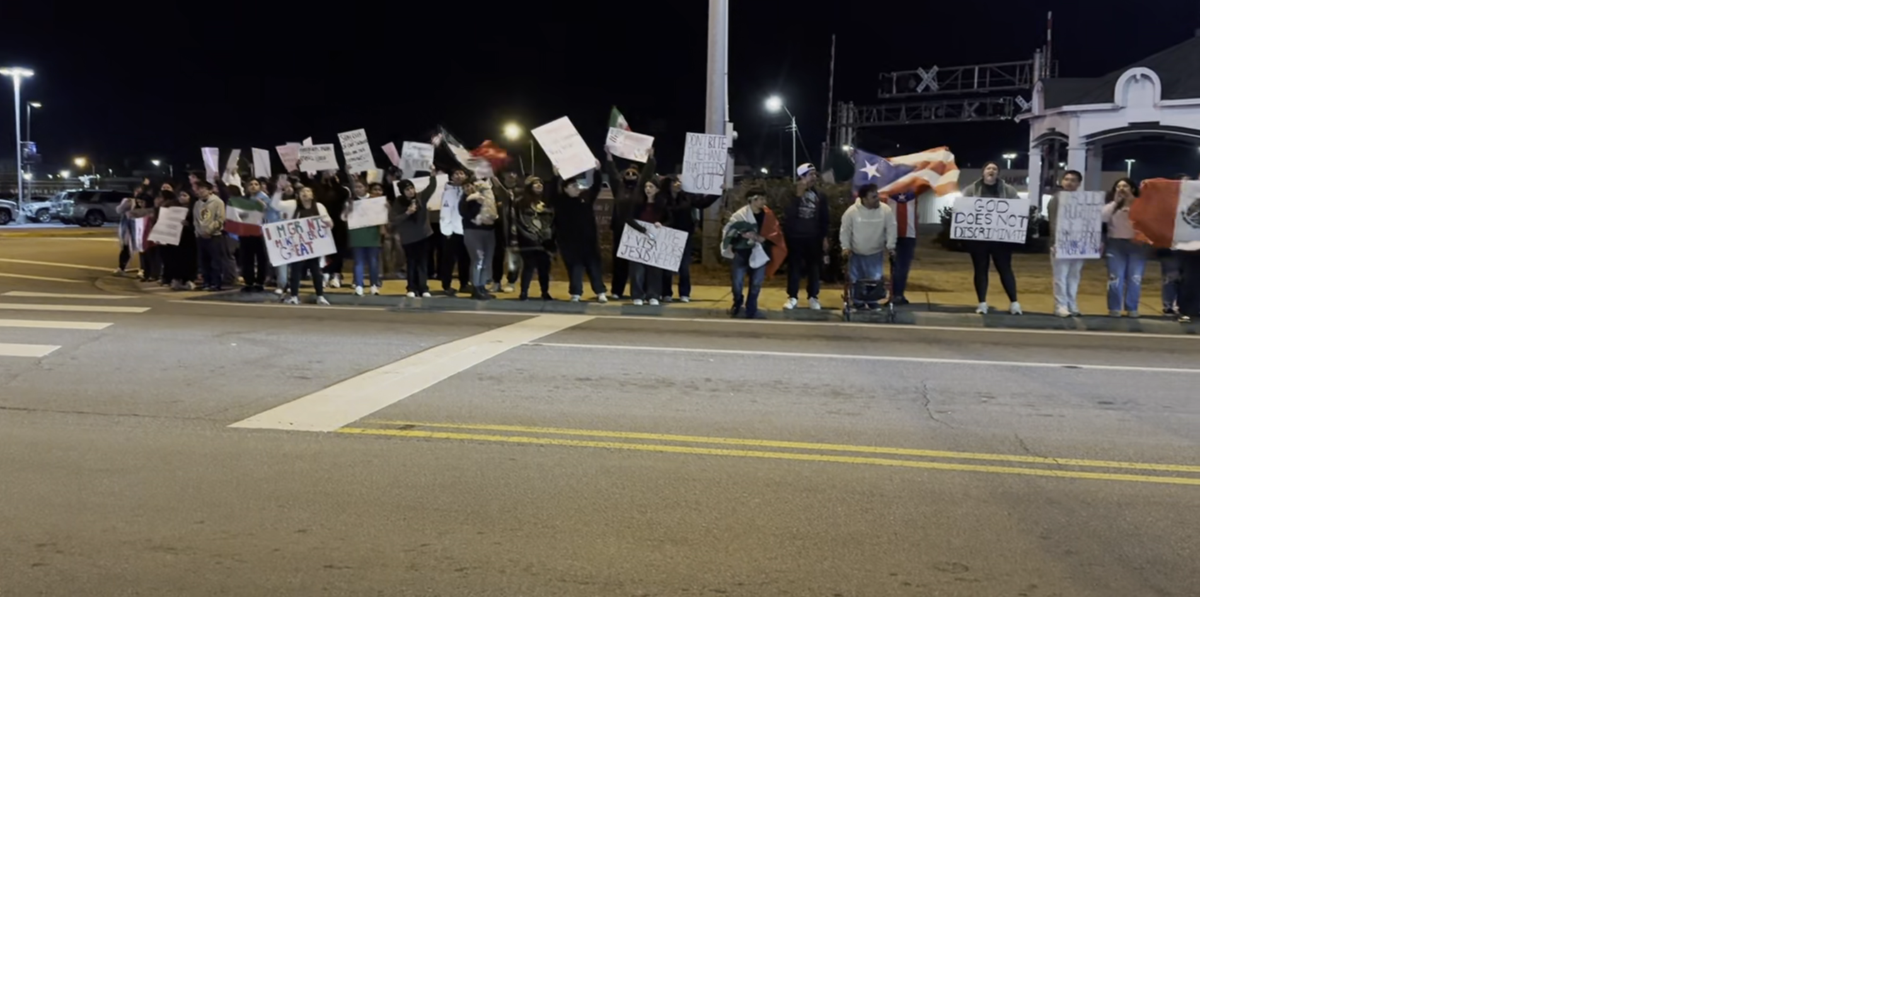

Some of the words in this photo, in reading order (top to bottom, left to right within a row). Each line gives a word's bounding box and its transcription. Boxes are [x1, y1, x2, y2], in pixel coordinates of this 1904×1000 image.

[708, 136, 727, 149] BITE
[974, 199, 1010, 214] GOD
[955, 212, 992, 225] DOES
[996, 214, 1029, 228] NOT
[954, 226, 1026, 241] DISCRIMINATE
[635, 235, 658, 251] VISA
[621, 245, 651, 262] JESUS
